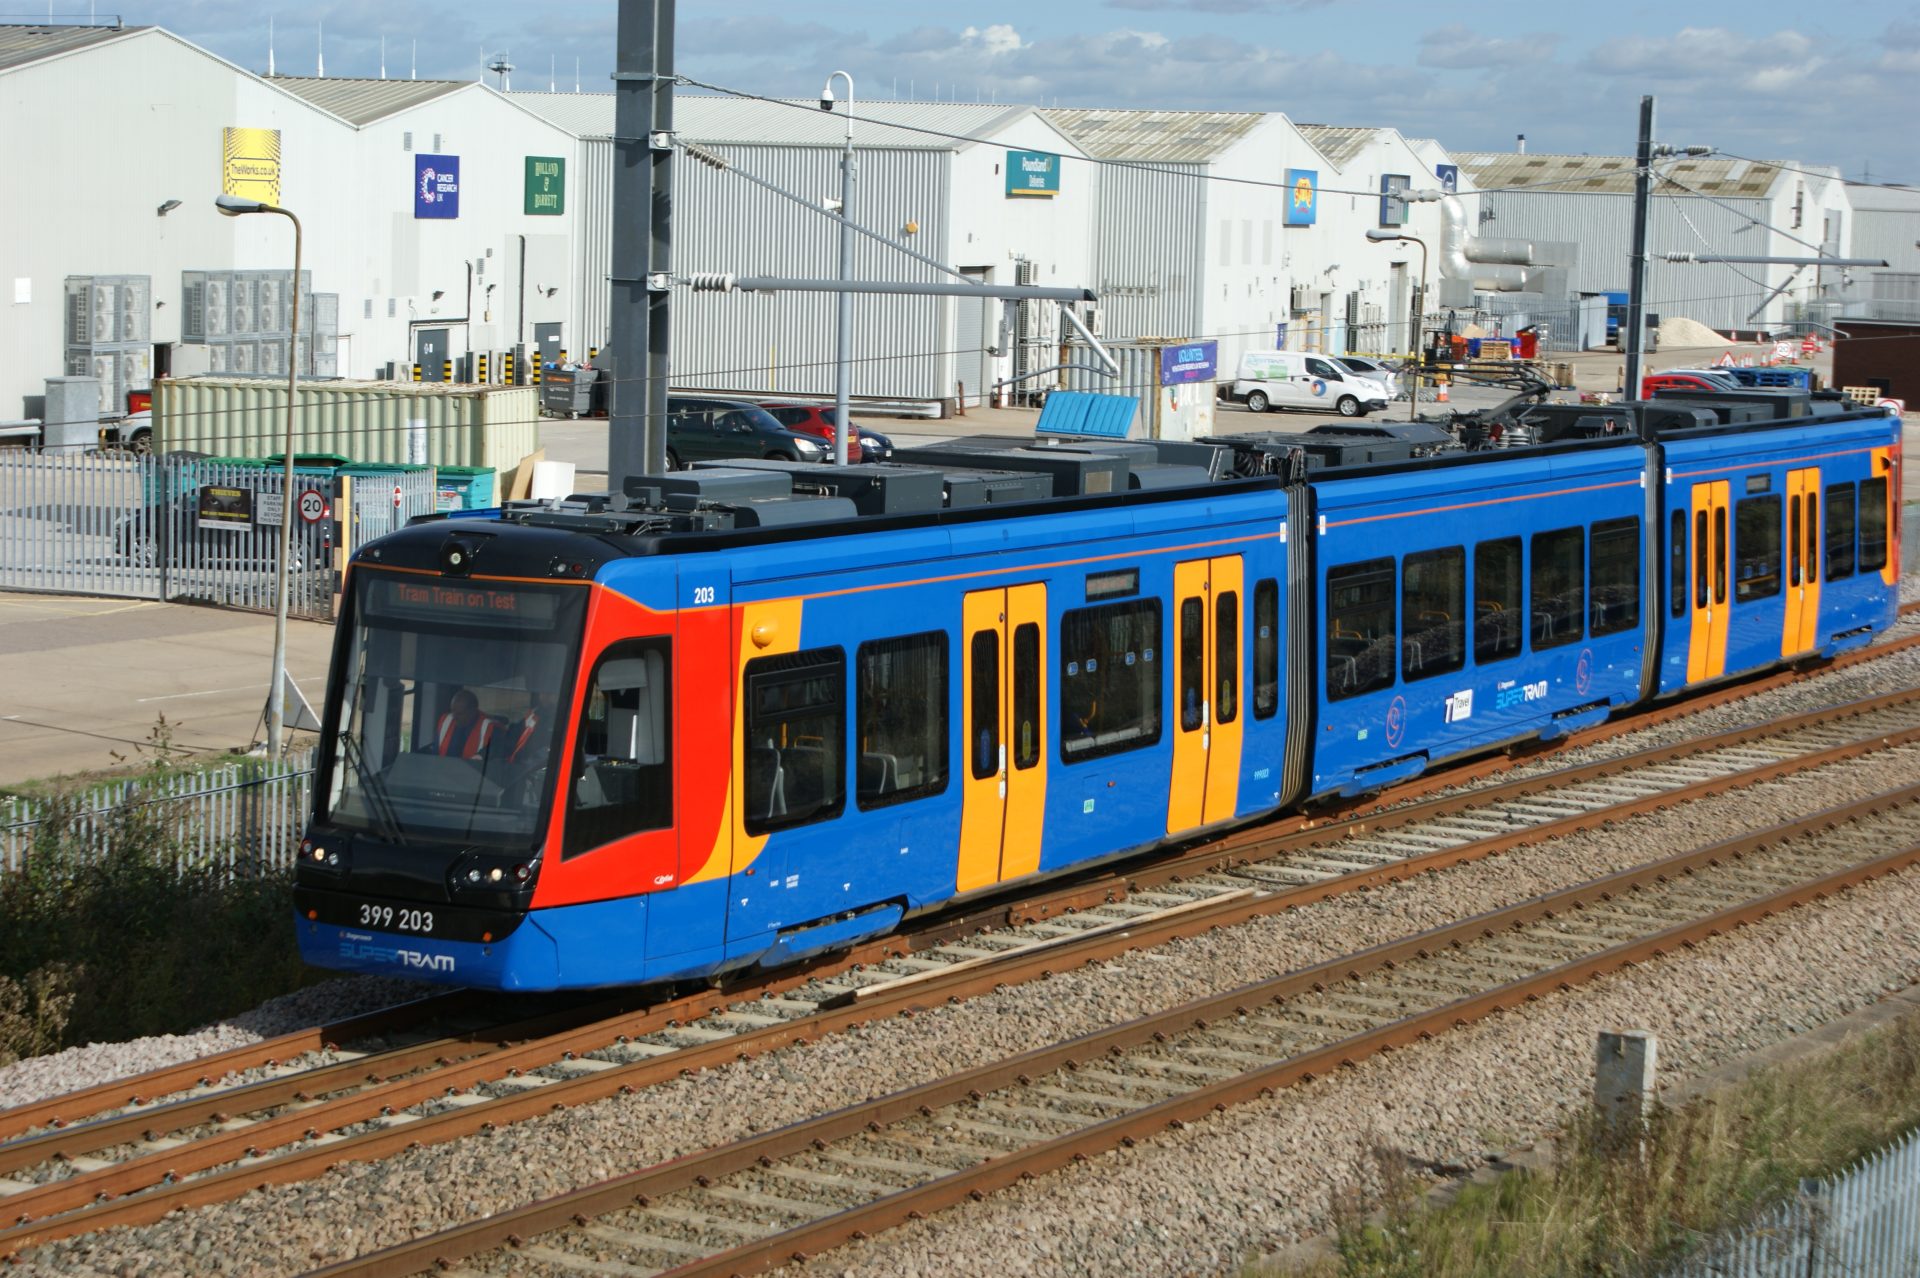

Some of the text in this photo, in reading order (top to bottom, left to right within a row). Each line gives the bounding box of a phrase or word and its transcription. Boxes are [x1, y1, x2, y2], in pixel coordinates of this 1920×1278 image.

[535, 162, 559, 177] HOLLAND
[437, 174, 454, 183] CANCER
[437, 183, 458, 193] RESEARCH
[437, 193, 444, 202] UK
[534, 194, 557, 208] BARRETT
[209, 488, 242, 497] THIEVES
[303, 499, 321, 512] 20
[399, 583, 516, 610] Tram Train on Test
[694, 586, 714, 604] 203
[1454, 696, 1470, 710] Travel
[360, 904, 434, 932] 399 203
